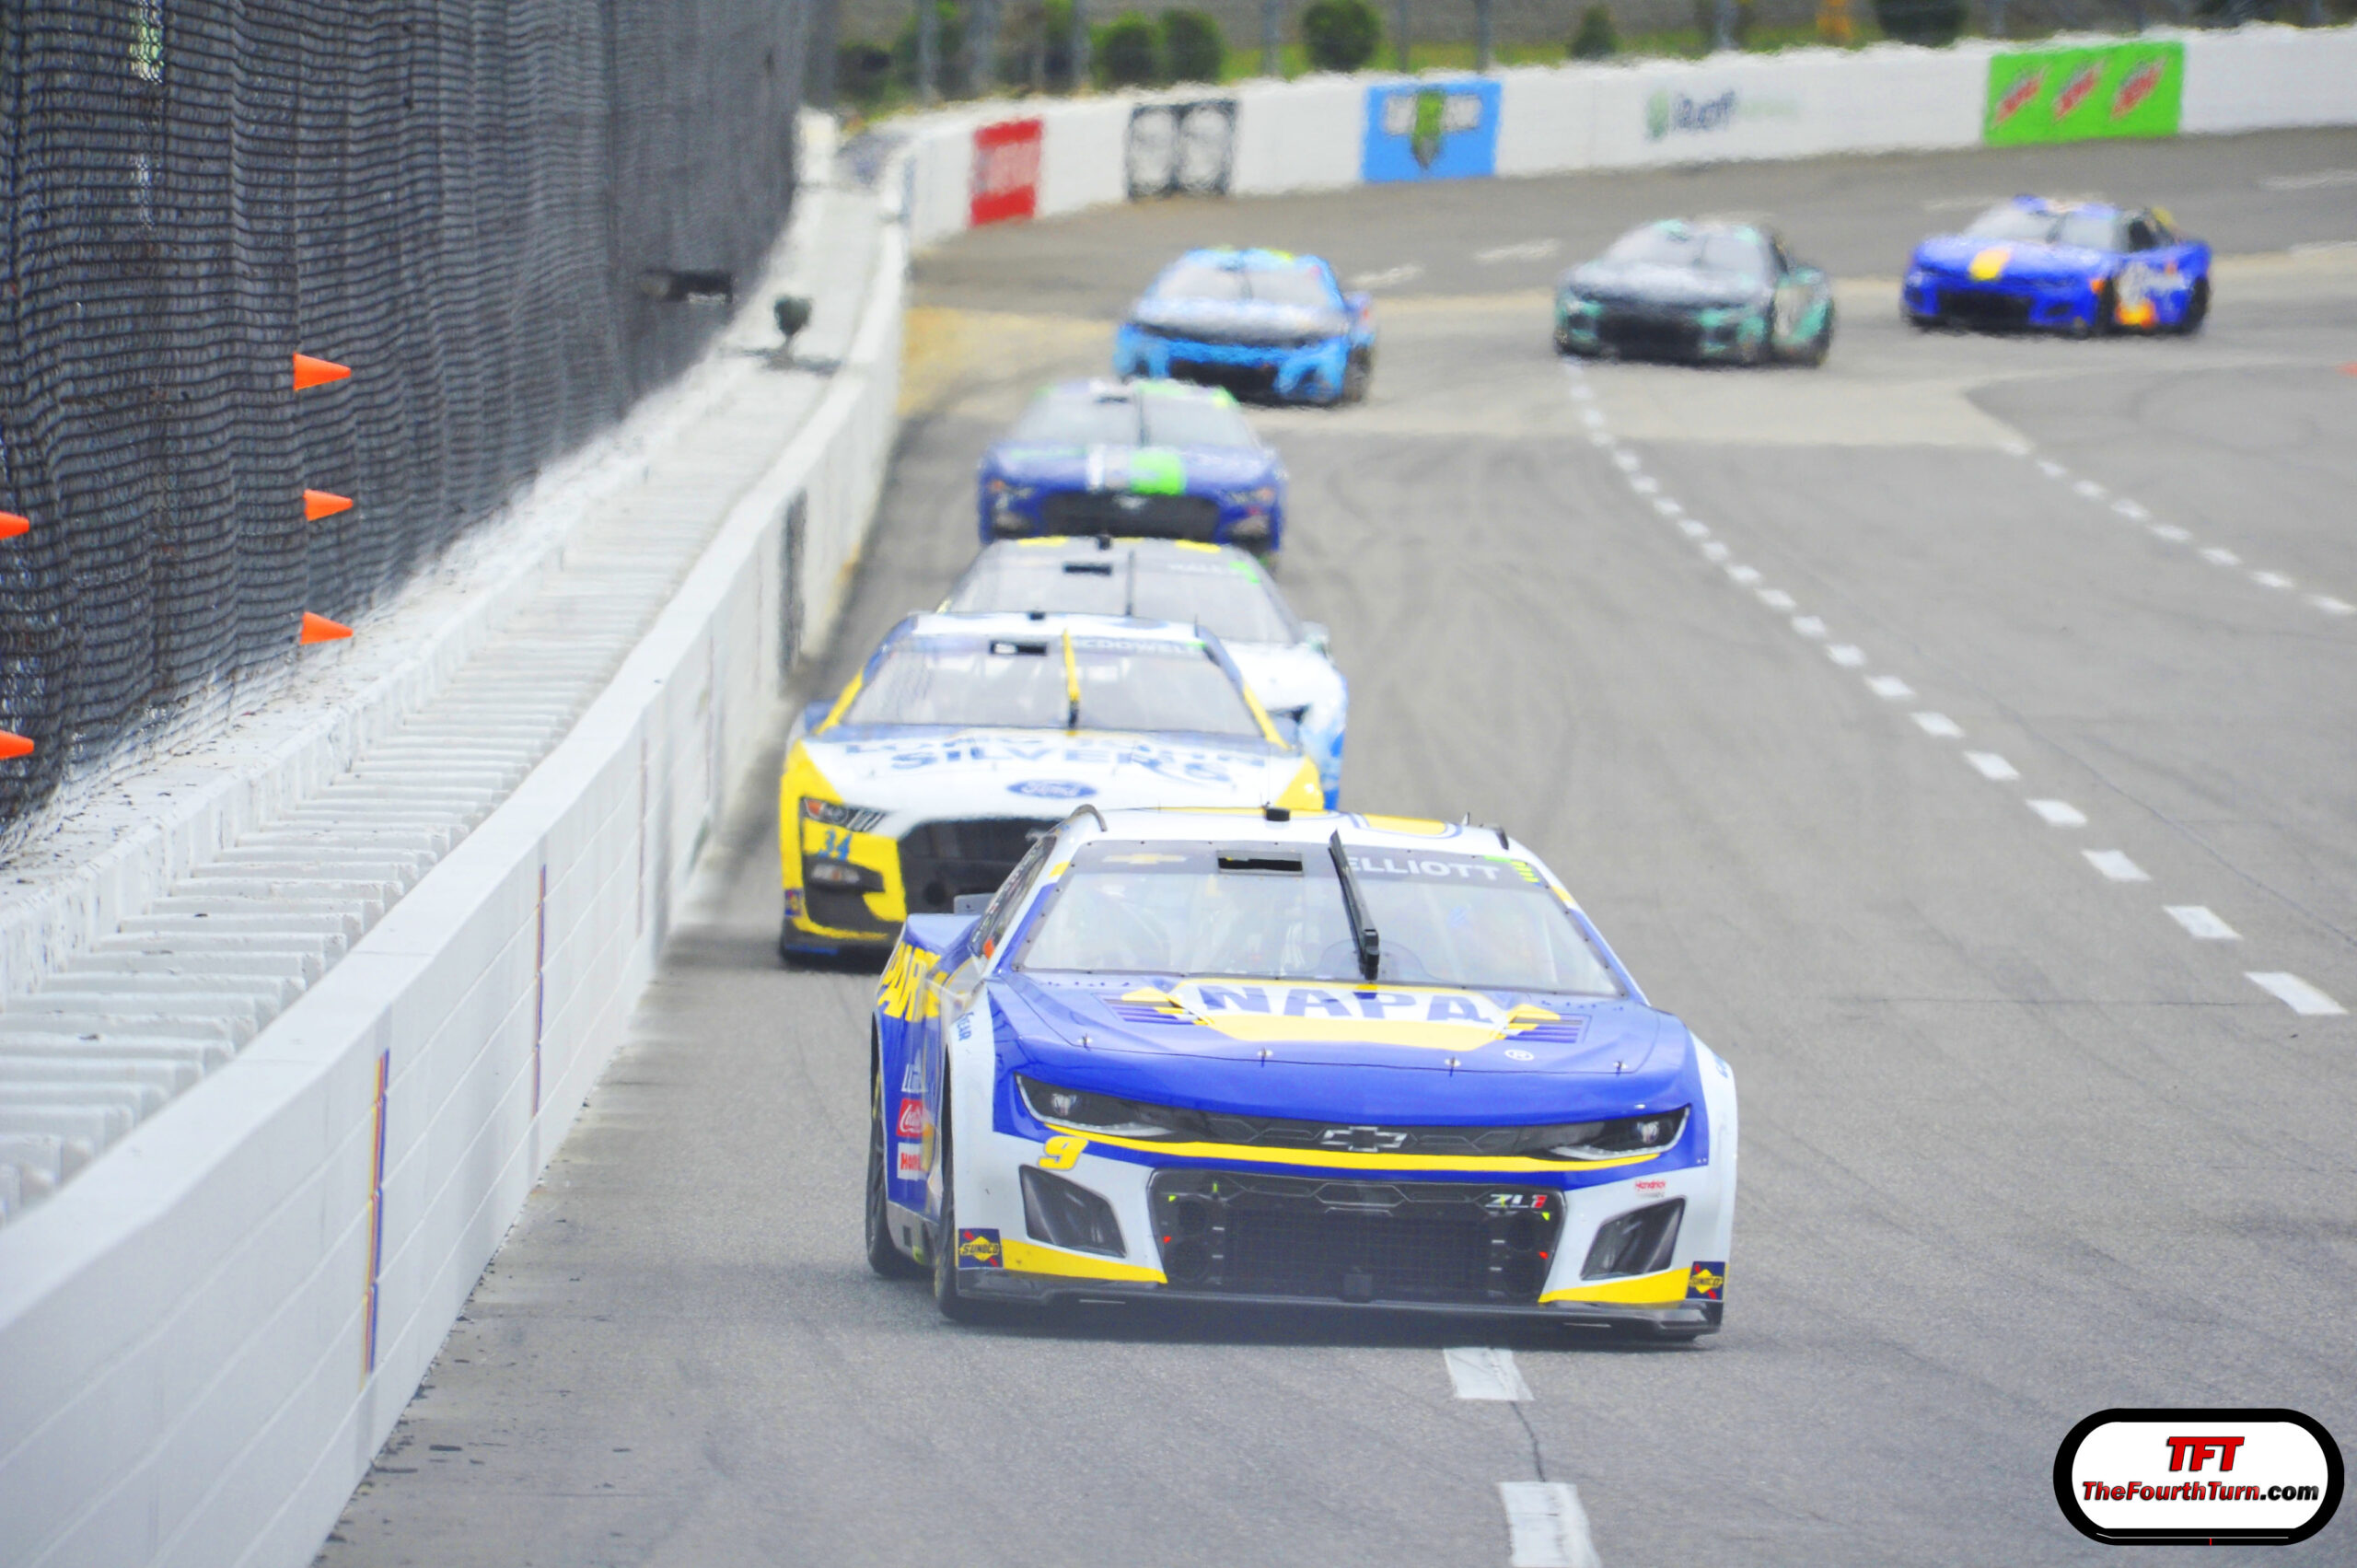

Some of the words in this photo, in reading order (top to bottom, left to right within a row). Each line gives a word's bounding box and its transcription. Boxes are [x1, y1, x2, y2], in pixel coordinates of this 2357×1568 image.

[817, 829, 853, 861] 34
[1343, 856, 1501, 881] ELLIOTT
[1197, 984, 1494, 1025] NAPA
[1038, 1135, 1089, 1170] 9
[1485, 1193, 1548, 1209] ZL1
[960, 1243, 1001, 1256] SUNOCO
[1691, 1277, 1722, 1287] SUNOCO
